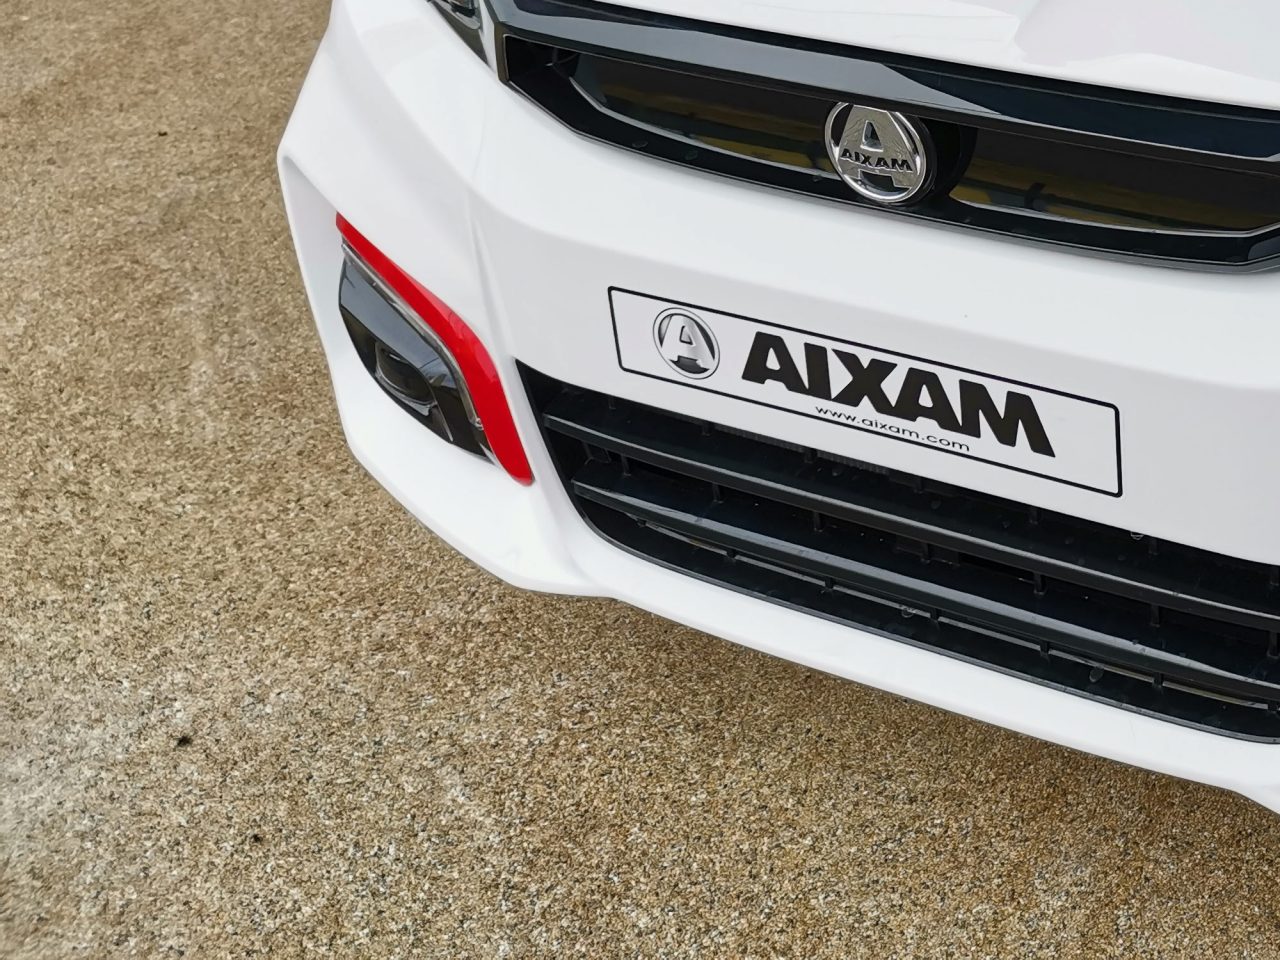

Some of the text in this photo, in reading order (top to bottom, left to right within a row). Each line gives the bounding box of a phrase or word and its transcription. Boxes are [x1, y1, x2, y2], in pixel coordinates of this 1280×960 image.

[840, 148, 913, 172] AIXAM
[742, 331, 1056, 458] AIXAM
[815, 406, 970, 452] www.aixam.com
